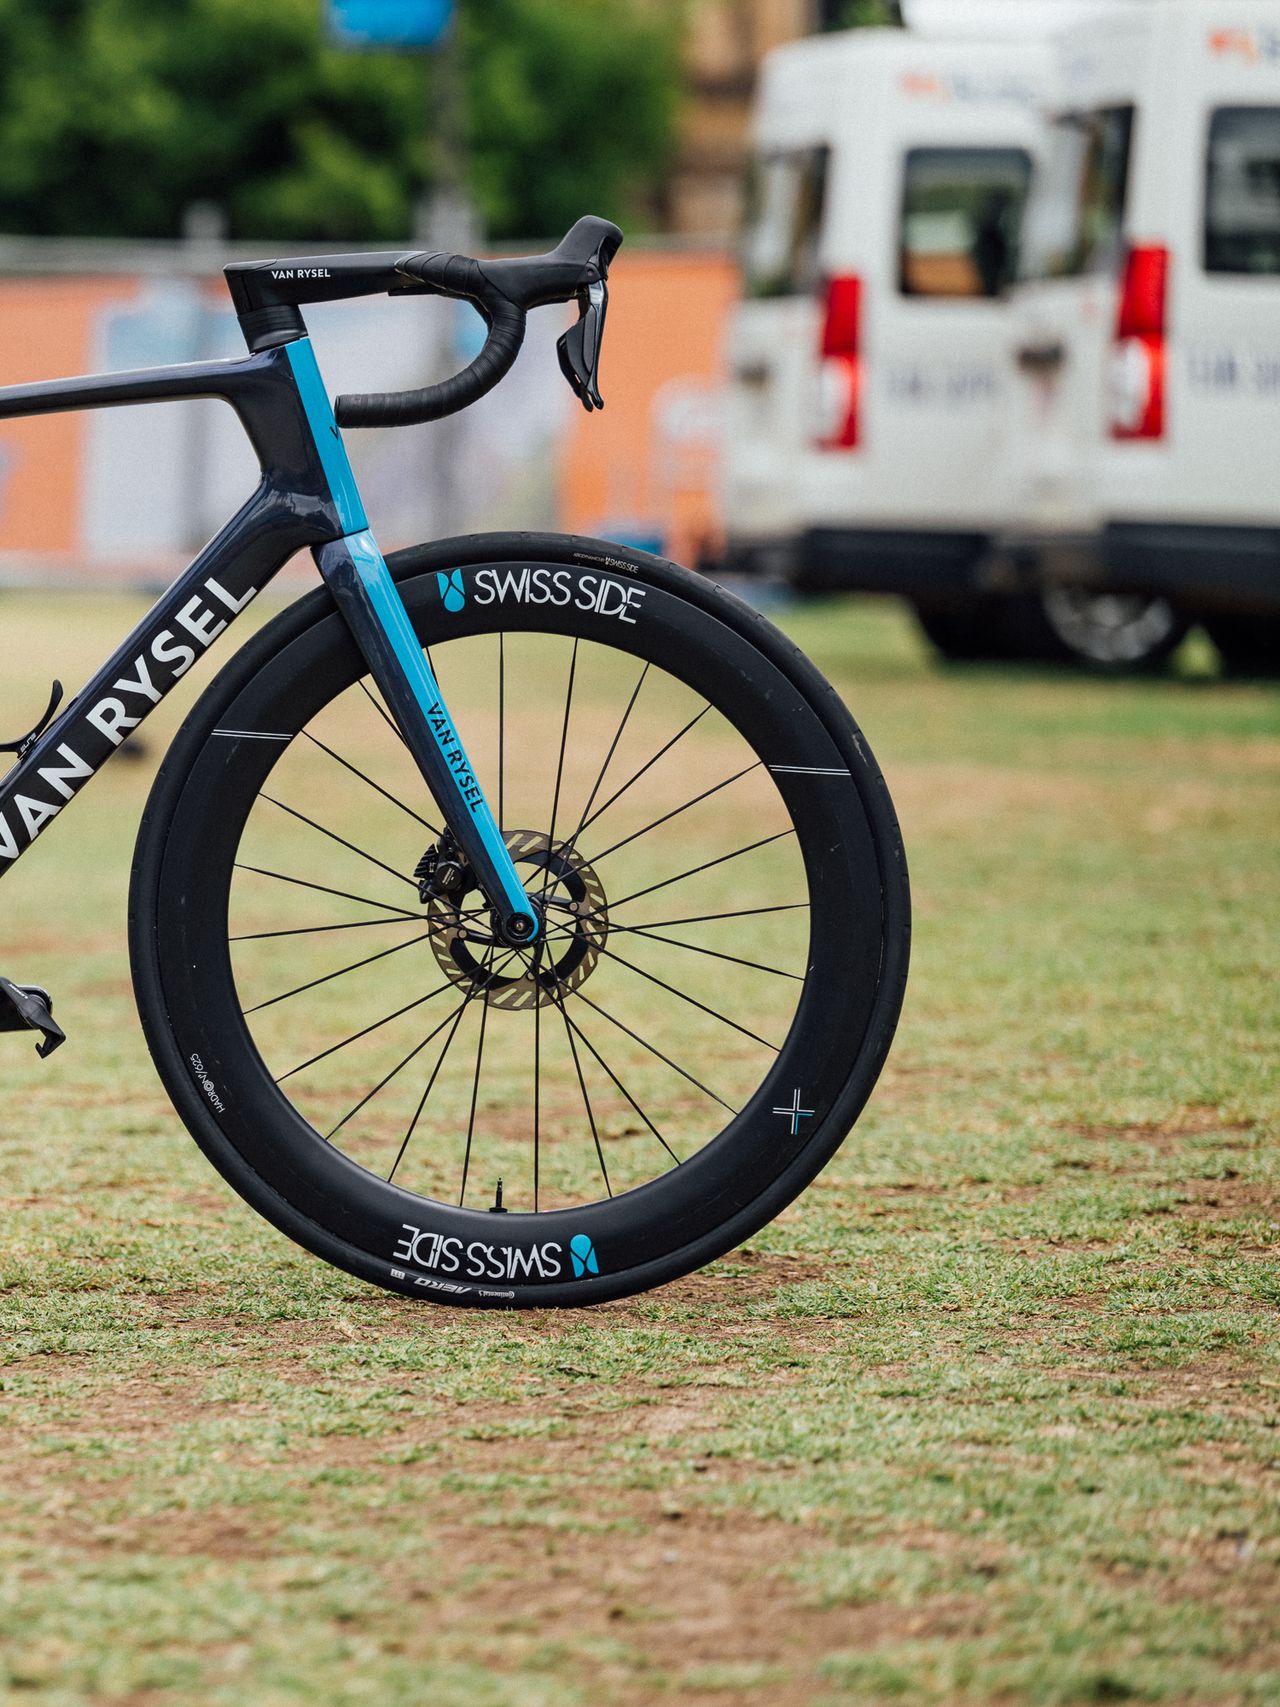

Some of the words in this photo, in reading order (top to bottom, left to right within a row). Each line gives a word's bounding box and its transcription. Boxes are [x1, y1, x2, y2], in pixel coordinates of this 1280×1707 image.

[271, 269, 294, 279] VAN
[297, 268, 331, 278] RYSEL
[473, 568, 571, 605] SWISS
[574, 575, 647, 624] SIDE
[85, 577, 258, 746] RYSEL
[427, 701, 455, 746] VAN
[447, 749, 484, 813] RYSEL
[392, 1223, 463, 1273] SIDE
[466, 1242, 562, 1279] SWISS
